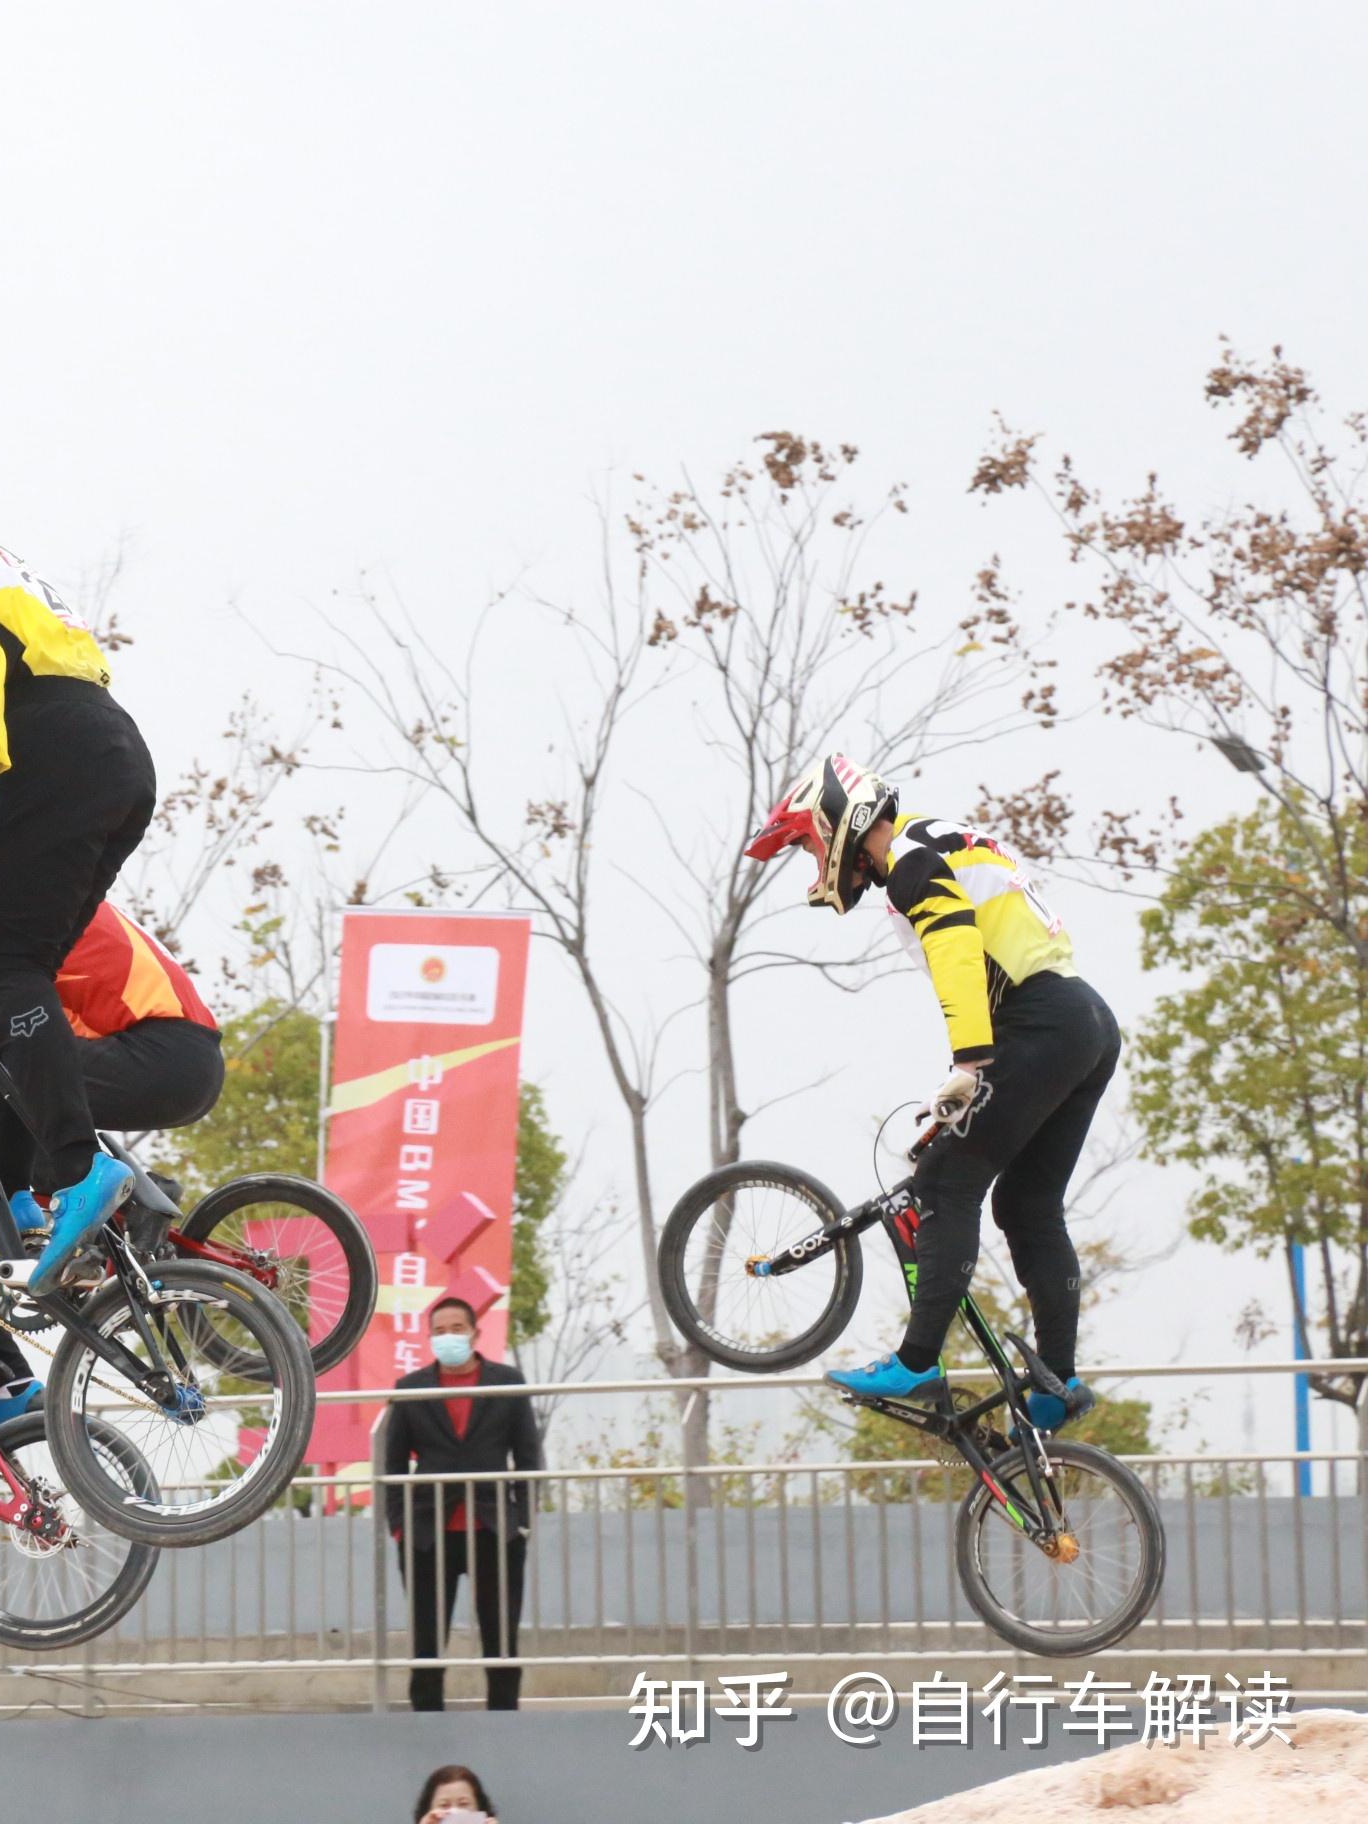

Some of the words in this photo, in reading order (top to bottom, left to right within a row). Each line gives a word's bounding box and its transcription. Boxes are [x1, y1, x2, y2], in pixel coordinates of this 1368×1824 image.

[395, 1054, 444, 1376] 中国BM自行车
